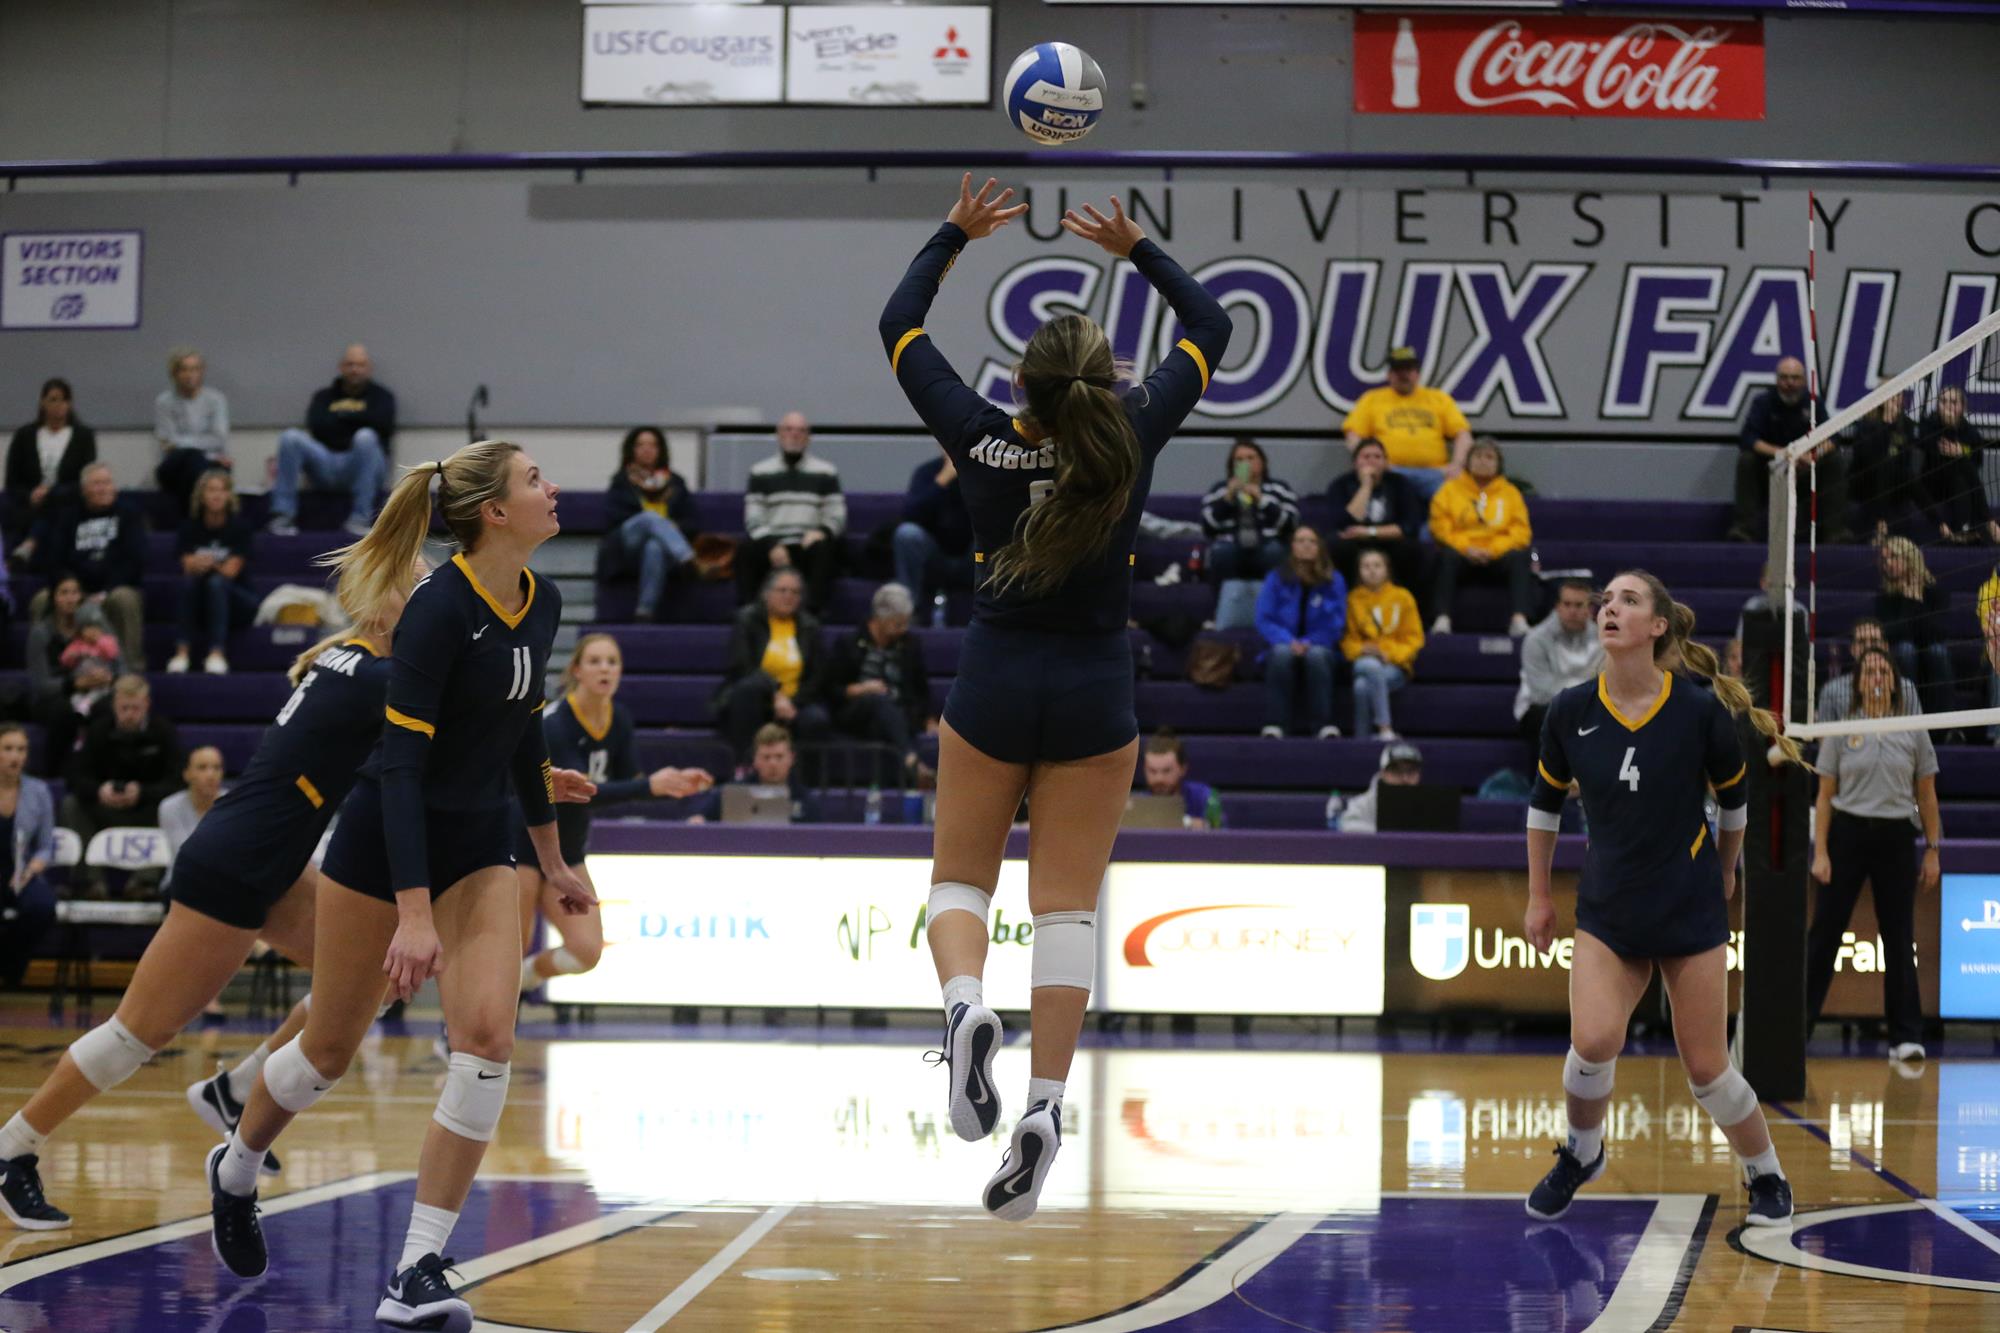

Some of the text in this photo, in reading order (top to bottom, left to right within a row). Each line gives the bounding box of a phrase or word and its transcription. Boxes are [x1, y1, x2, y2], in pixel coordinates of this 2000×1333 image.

[592, 31, 774, 62] USFCougars
[1455, 20, 1733, 110] Coca-Cola
[1031, 122, 1087, 140] molten
[1023, 186, 1850, 252] UNIVERSITY
[20, 240, 124, 260] VISITORS
[19, 265, 120, 286] SECTION
[970, 255, 1592, 420] SIOUX
[969, 434, 1054, 470] AUGUS
[506, 646, 532, 700] 11
[1618, 746, 1641, 792] 4
[106, 835, 157, 861] USF
[1160, 927, 1358, 953] JOURNEY
[1474, 927, 1577, 969] Unive
